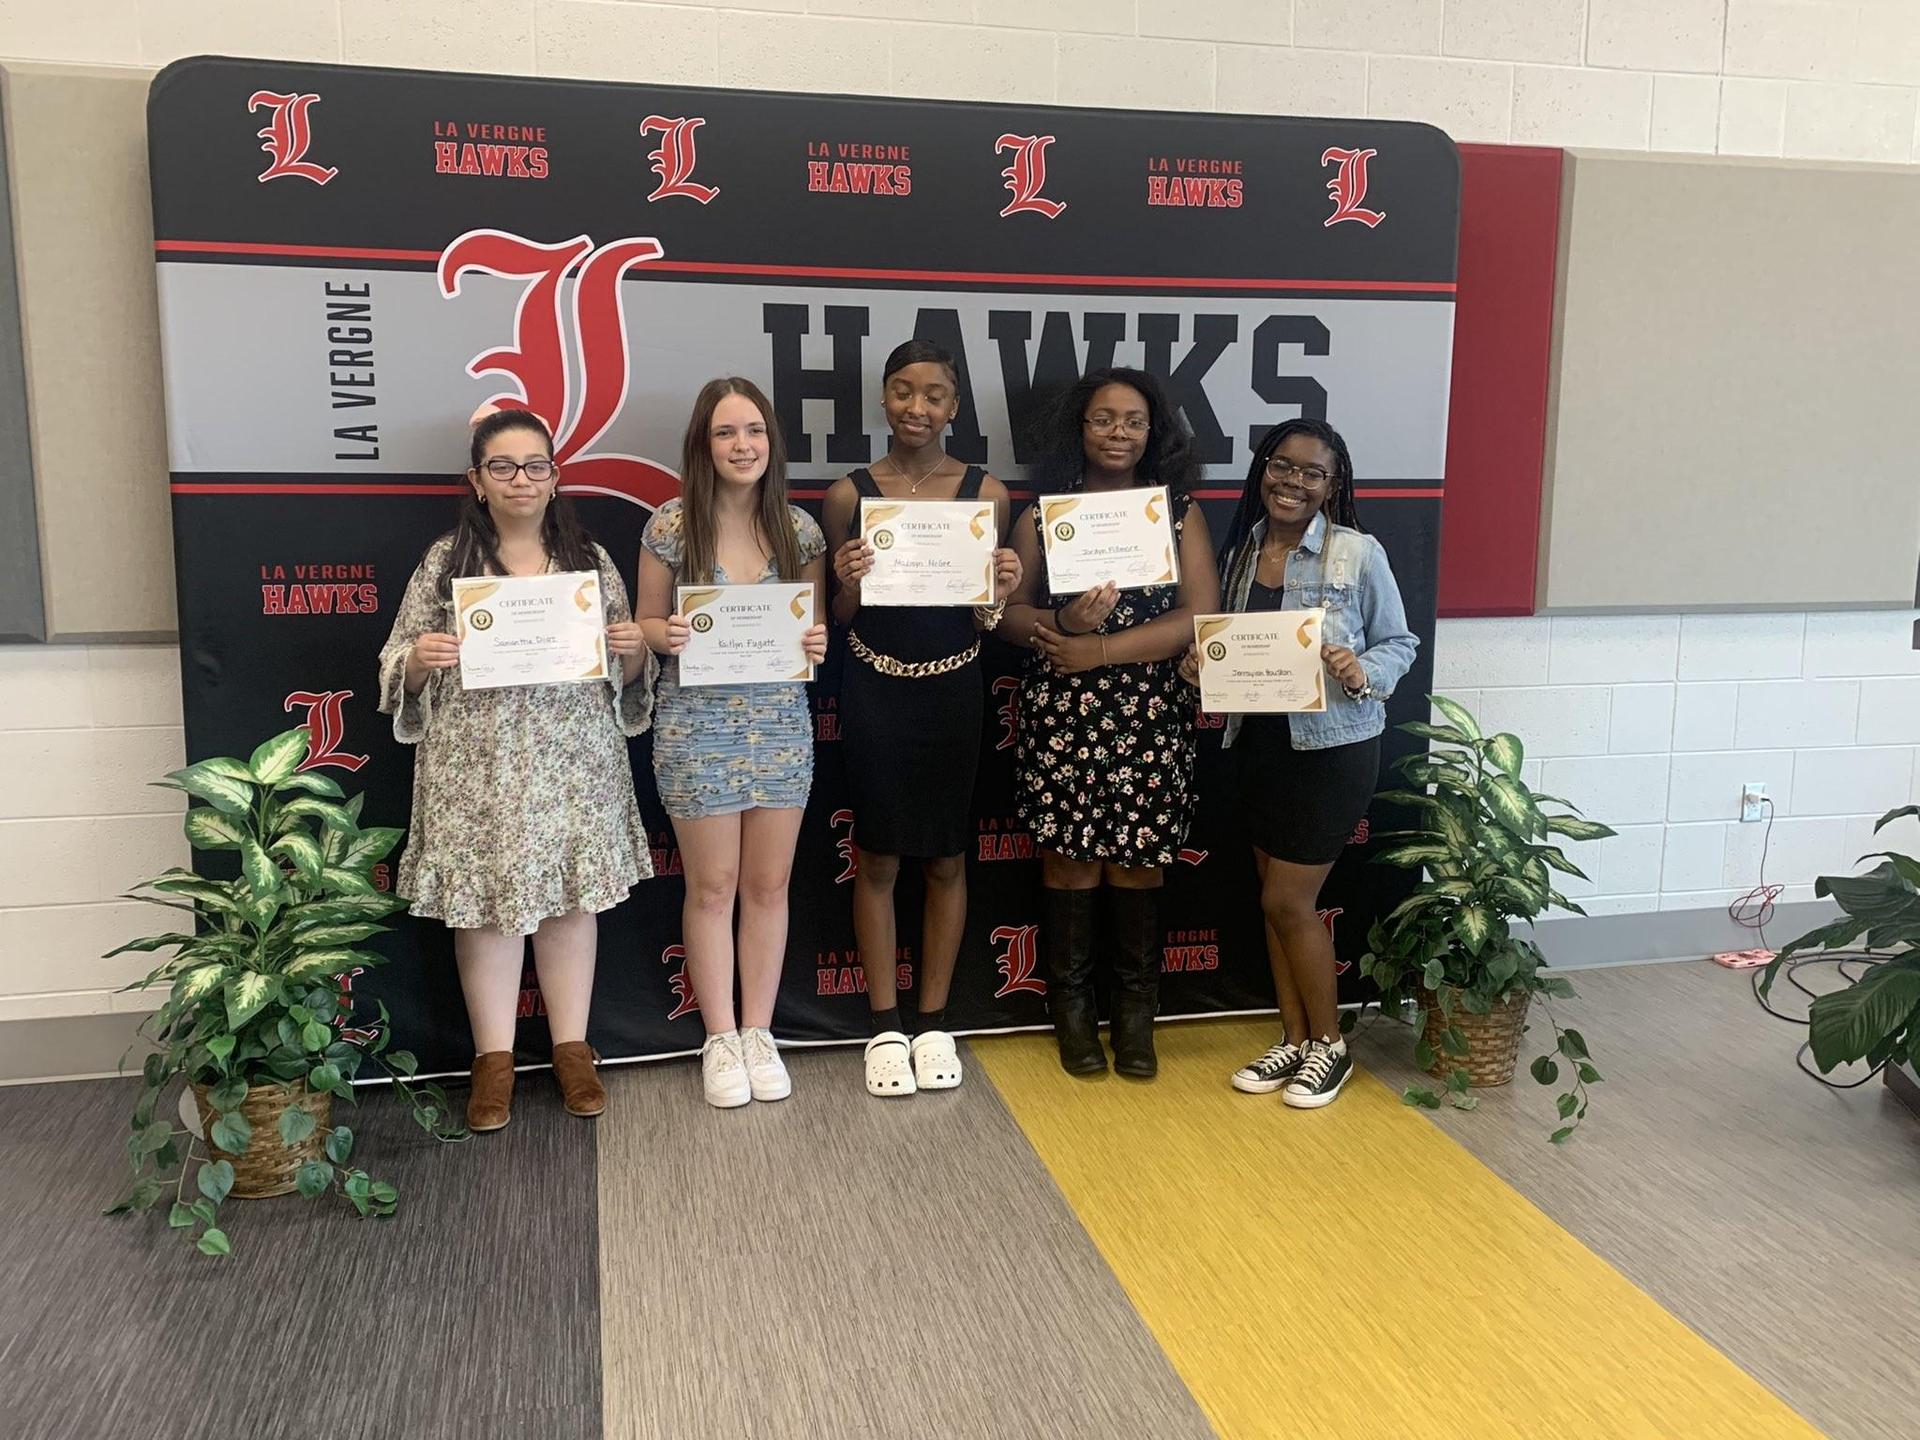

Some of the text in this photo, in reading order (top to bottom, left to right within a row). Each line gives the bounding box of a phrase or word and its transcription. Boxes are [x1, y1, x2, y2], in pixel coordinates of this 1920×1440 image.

[434, 121, 546, 142] LA VERGNE
[435, 141, 549, 178] HAWKS
[808, 142, 911, 161] LA VERGNE
[1148, 157, 1243, 174] LA VERGNE
[808, 161, 912, 195] HAWKS
[1148, 176, 1243, 208] HAWKS
[325, 281, 380, 460] LA VERGNE
[900, 522, 950, 531] CERTIFICATE
[261, 564, 375, 580] LA VERGNE
[262, 584, 378, 614] HAWKS
[719, 604, 772, 613] CERTIFICATE
[1230, 632, 1280, 641] CERTIFICATE
